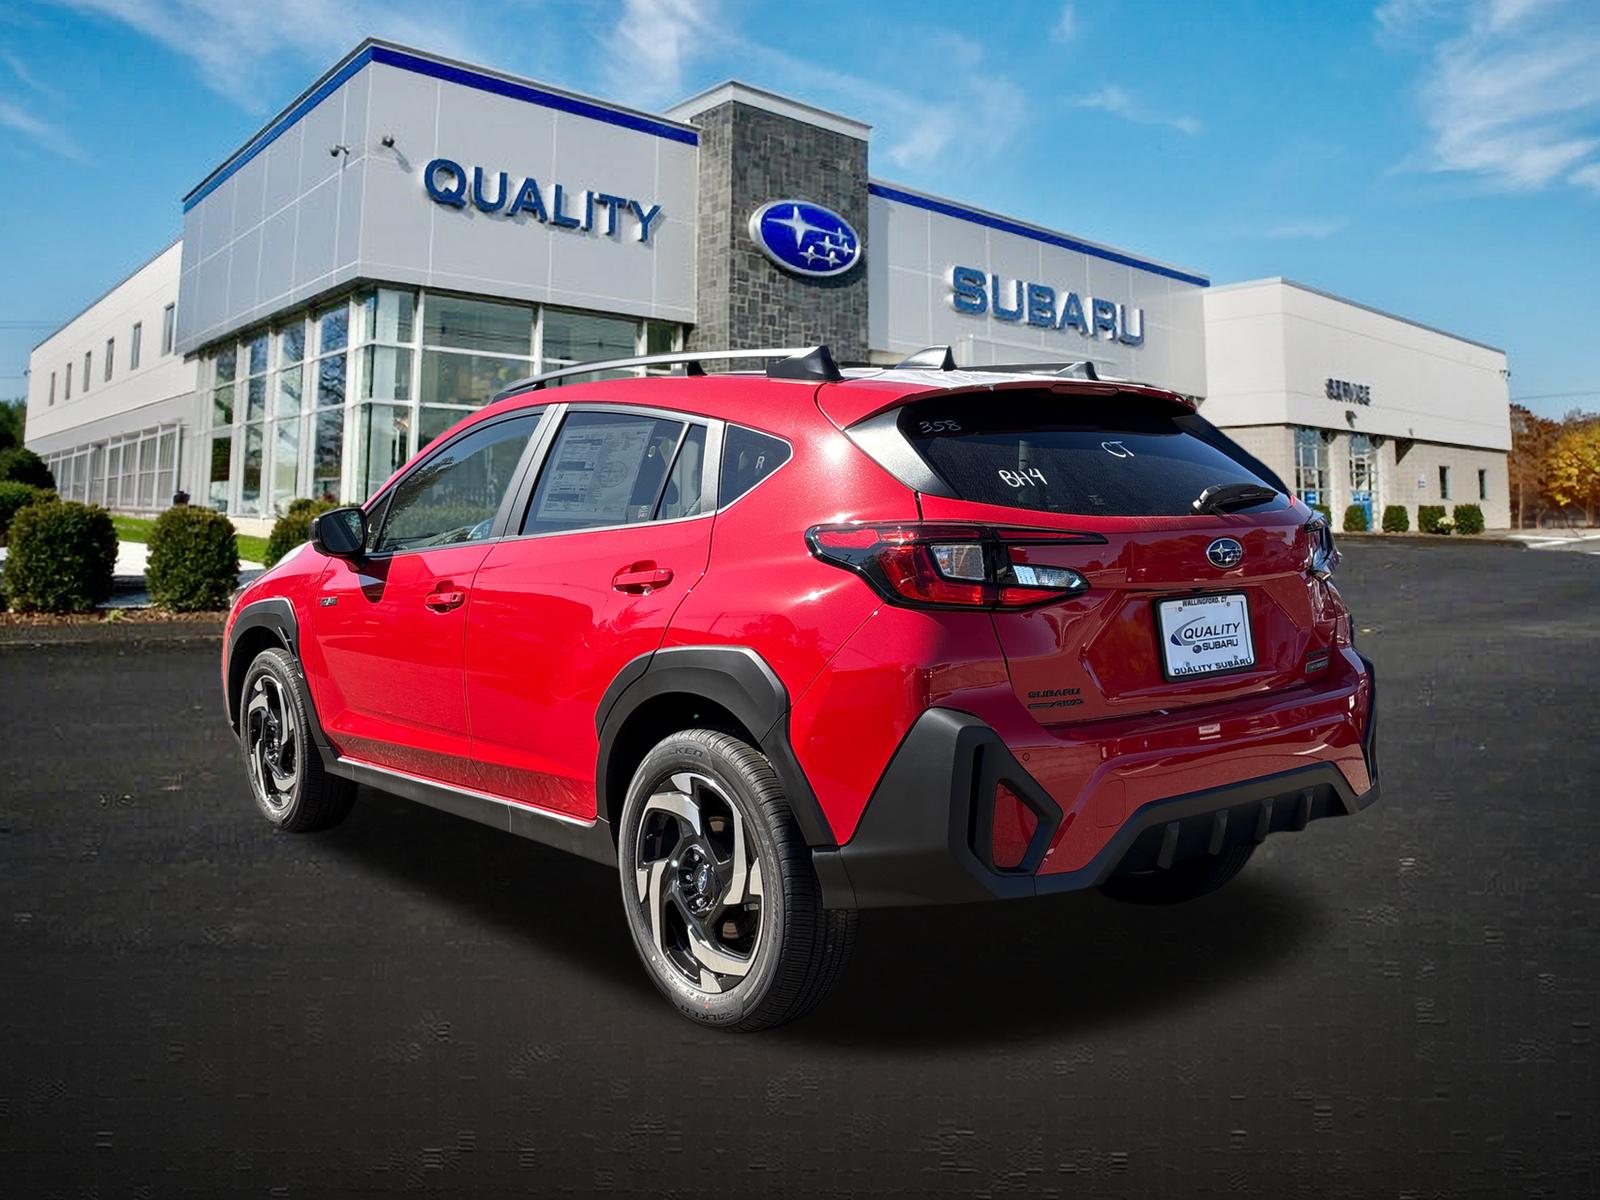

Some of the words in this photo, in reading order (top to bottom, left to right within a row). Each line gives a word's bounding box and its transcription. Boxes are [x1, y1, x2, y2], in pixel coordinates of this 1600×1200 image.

[424, 158, 661, 243] QUALITY
[950, 265, 1145, 347] SUBARU
[919, 419, 962, 434] 358
[1101, 440, 1135, 459] CT
[998, 468, 1048, 488] BH4
[1183, 622, 1241, 640] QUALITY
[1202, 638, 1239, 652] SUBARU
[1173, 664, 1213, 675] QUALITY
[1215, 657, 1253, 669] SUBARU
[1027, 687, 1081, 699] SUBARU
